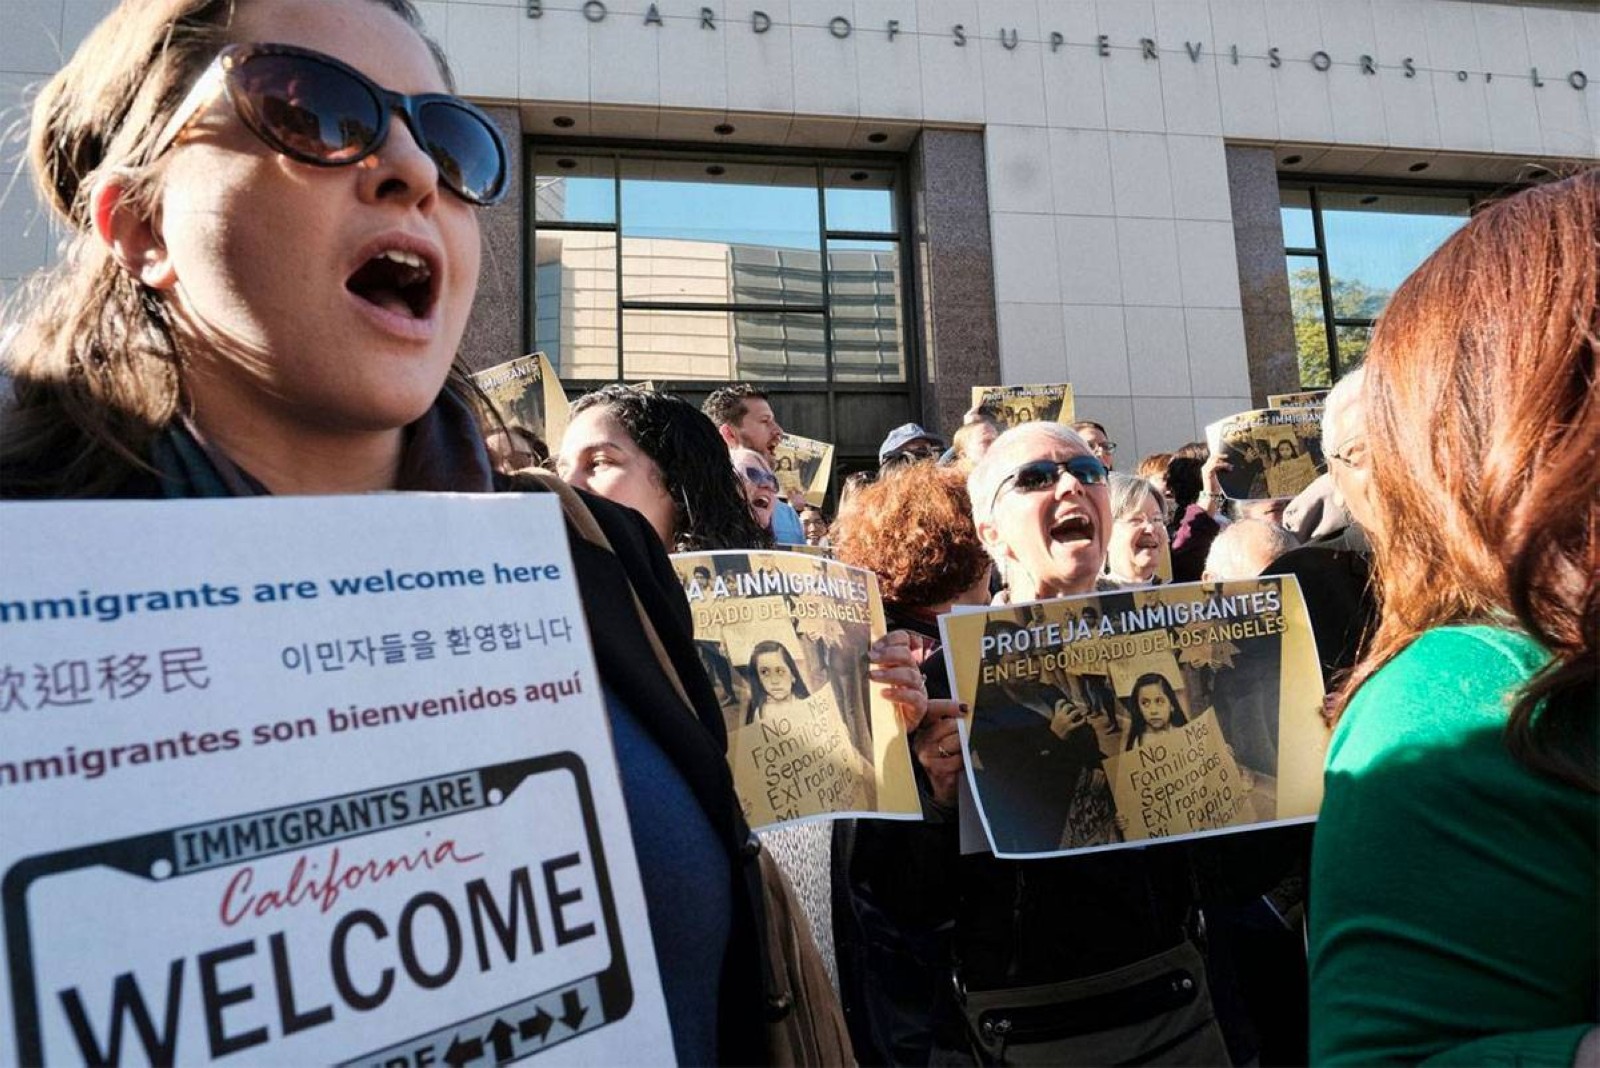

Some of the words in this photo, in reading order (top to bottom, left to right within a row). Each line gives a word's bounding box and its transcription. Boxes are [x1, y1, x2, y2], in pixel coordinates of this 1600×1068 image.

[526, 0, 772, 34] BOARD
[829, 16, 900, 43] OF
[953, 24, 1417, 79] SUPERVISORS
[1529, 66, 1588, 91] LO
[0, 582, 241, 623] mmigrants
[253, 578, 318, 602] are
[329, 565, 485, 597] welcome
[493, 562, 561, 584] here
[697, 604, 750, 628] DADO
[757, 602, 784, 621] DE
[787, 600, 816, 618] LOS
[820, 601, 873, 625] ANGELES
[713, 575, 731, 599] A
[736, 572, 869, 603] INMIGRANTES
[281, 629, 437, 675] 이민자들을
[446, 615, 573, 657] 환영합니다
[980, 619, 1092, 659] PROTEJA
[1098, 613, 1116, 638] A
[1119, 590, 1281, 633] INMIGRANTES
[982, 663, 1009, 685] EN
[1015, 656, 1040, 678] EL
[1043, 640, 1136, 672] CONDADO
[1142, 635, 1167, 655] DE
[1170, 629, 1203, 650] LOS
[1208, 615, 1288, 644] ANGELES
[252, 716, 317, 746] son
[328, 686, 517, 734] bienvenidos
[524, 670, 583, 705] aquí
[761, 717, 792, 744] No
[1138, 744, 1167, 769] No
[181, 790, 411, 867] IMMIGRANTS
[418, 776, 476, 817] ARE
[218, 831, 485, 927] California
[57, 851, 597, 1068] WELCOME
